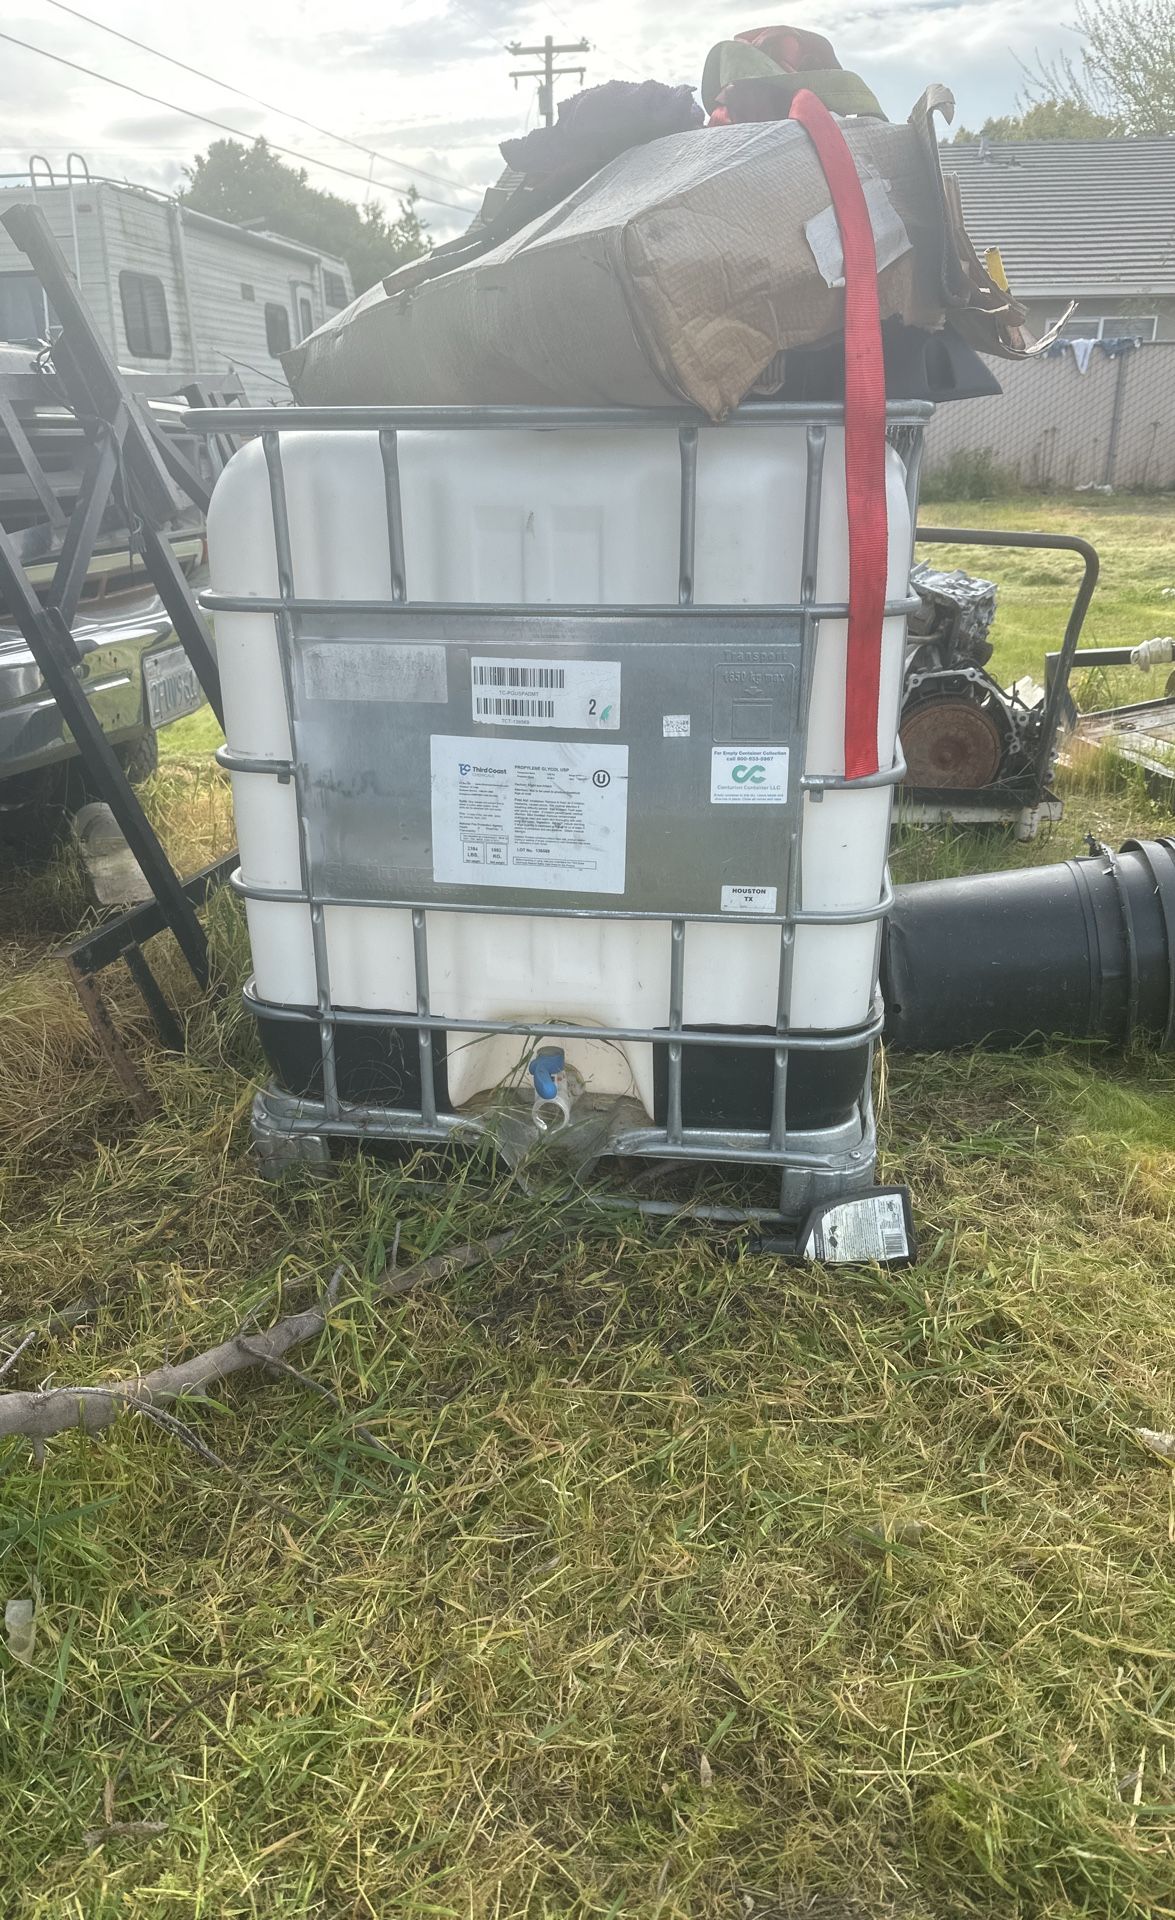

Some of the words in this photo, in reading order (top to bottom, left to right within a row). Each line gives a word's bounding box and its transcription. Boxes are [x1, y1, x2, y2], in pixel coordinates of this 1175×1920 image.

[724, 650, 787, 662] Transport
[588, 698, 597, 716] 2
[488, 767, 507, 775] Coast
